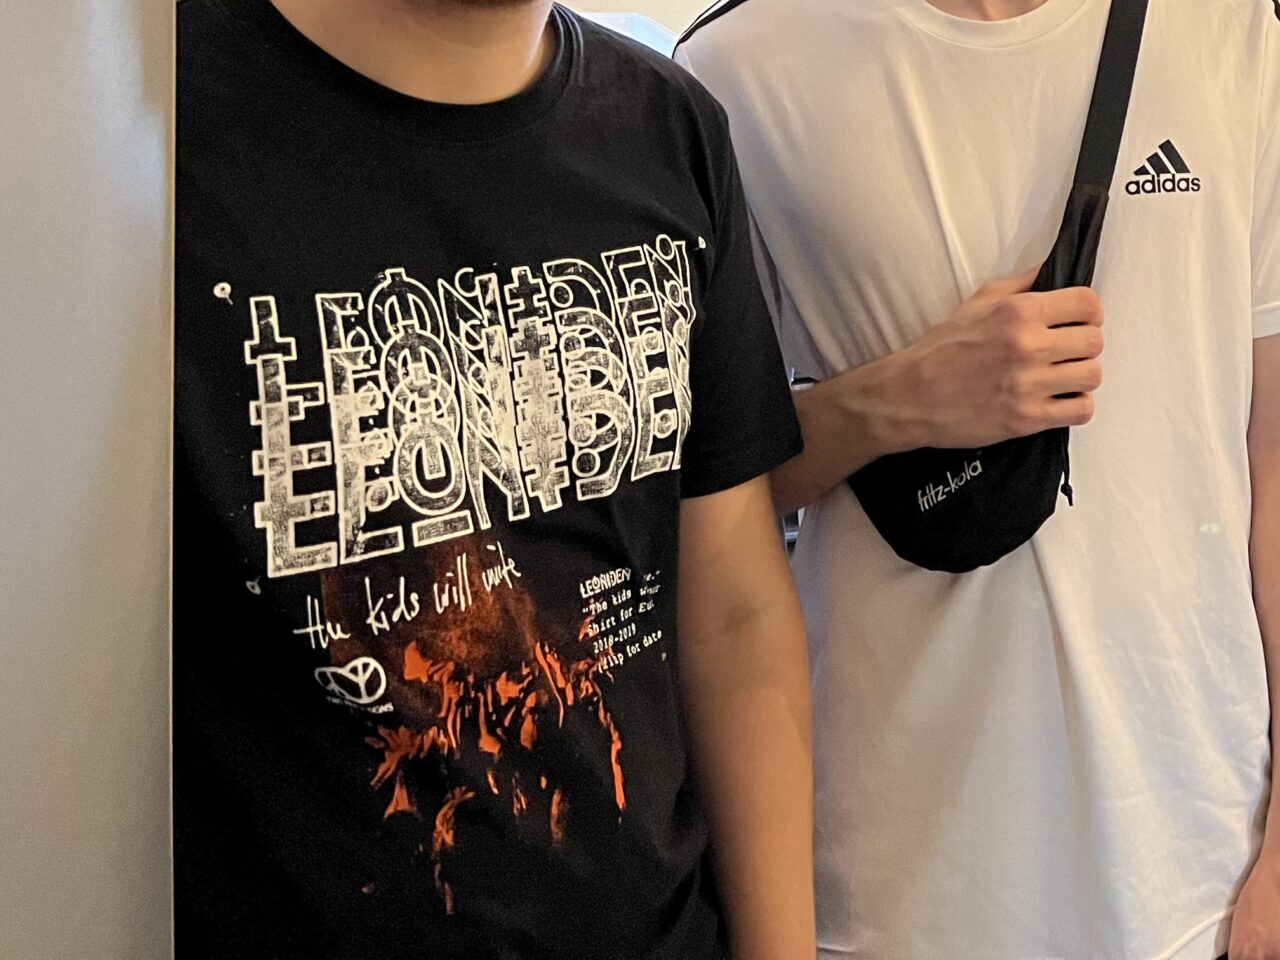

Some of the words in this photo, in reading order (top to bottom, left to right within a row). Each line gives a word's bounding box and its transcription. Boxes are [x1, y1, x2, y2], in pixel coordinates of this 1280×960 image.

[1125, 173, 1201, 195] adidas
[917, 459, 983, 513] fritz-kola
[364, 576, 421, 636] kids
[433, 552, 473, 615] will
[611, 588, 632, 606] kids
[593, 622, 637, 655] 2018-2019
